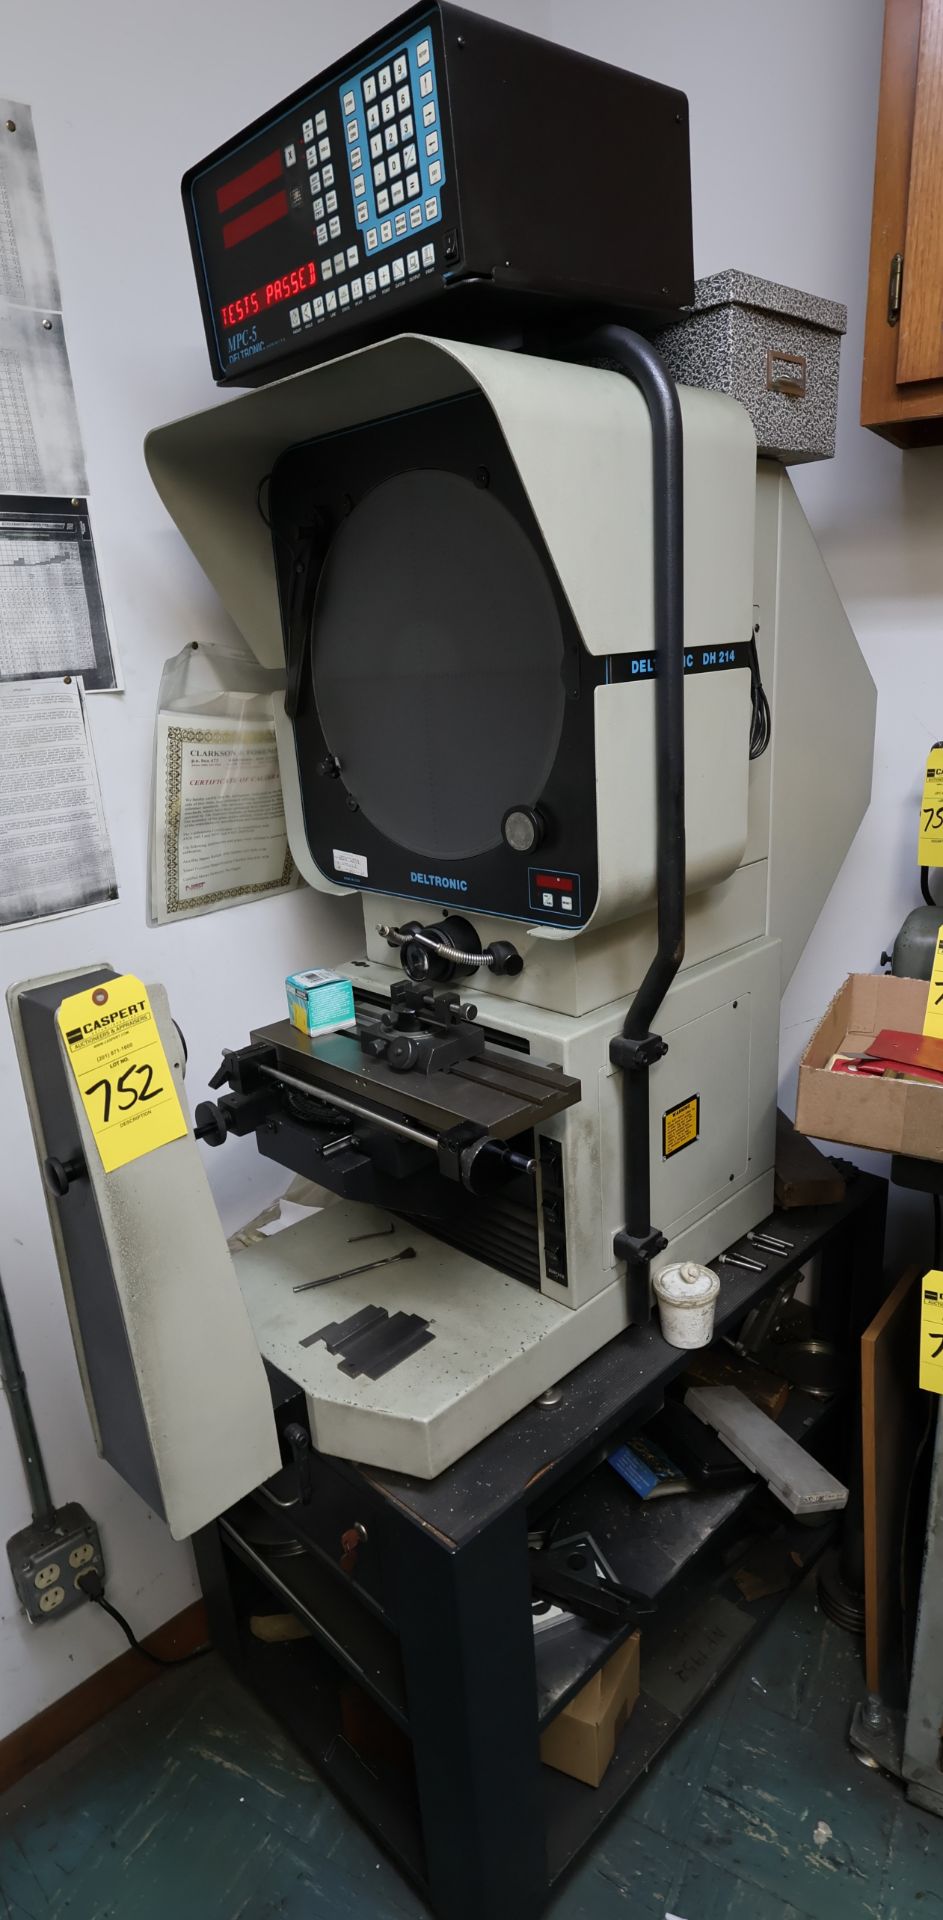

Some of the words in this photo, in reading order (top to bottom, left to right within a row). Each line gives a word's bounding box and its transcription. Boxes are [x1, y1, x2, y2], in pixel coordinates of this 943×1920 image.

[221, 292, 259, 326] TESTS
[265, 262, 317, 304] PASSED
[228, 325, 257, 352] MPC-5
[228, 341, 265, 364] DELTRONIC
[702, 652, 717, 665] DH
[719, 650, 736, 664] 214
[410, 871, 468, 892] DELTRONIC
[82, 1001, 146, 1034] CASPERT
[85, 1064, 163, 1122] 752
[119, 1110, 152, 1128] DESCRIPTION
